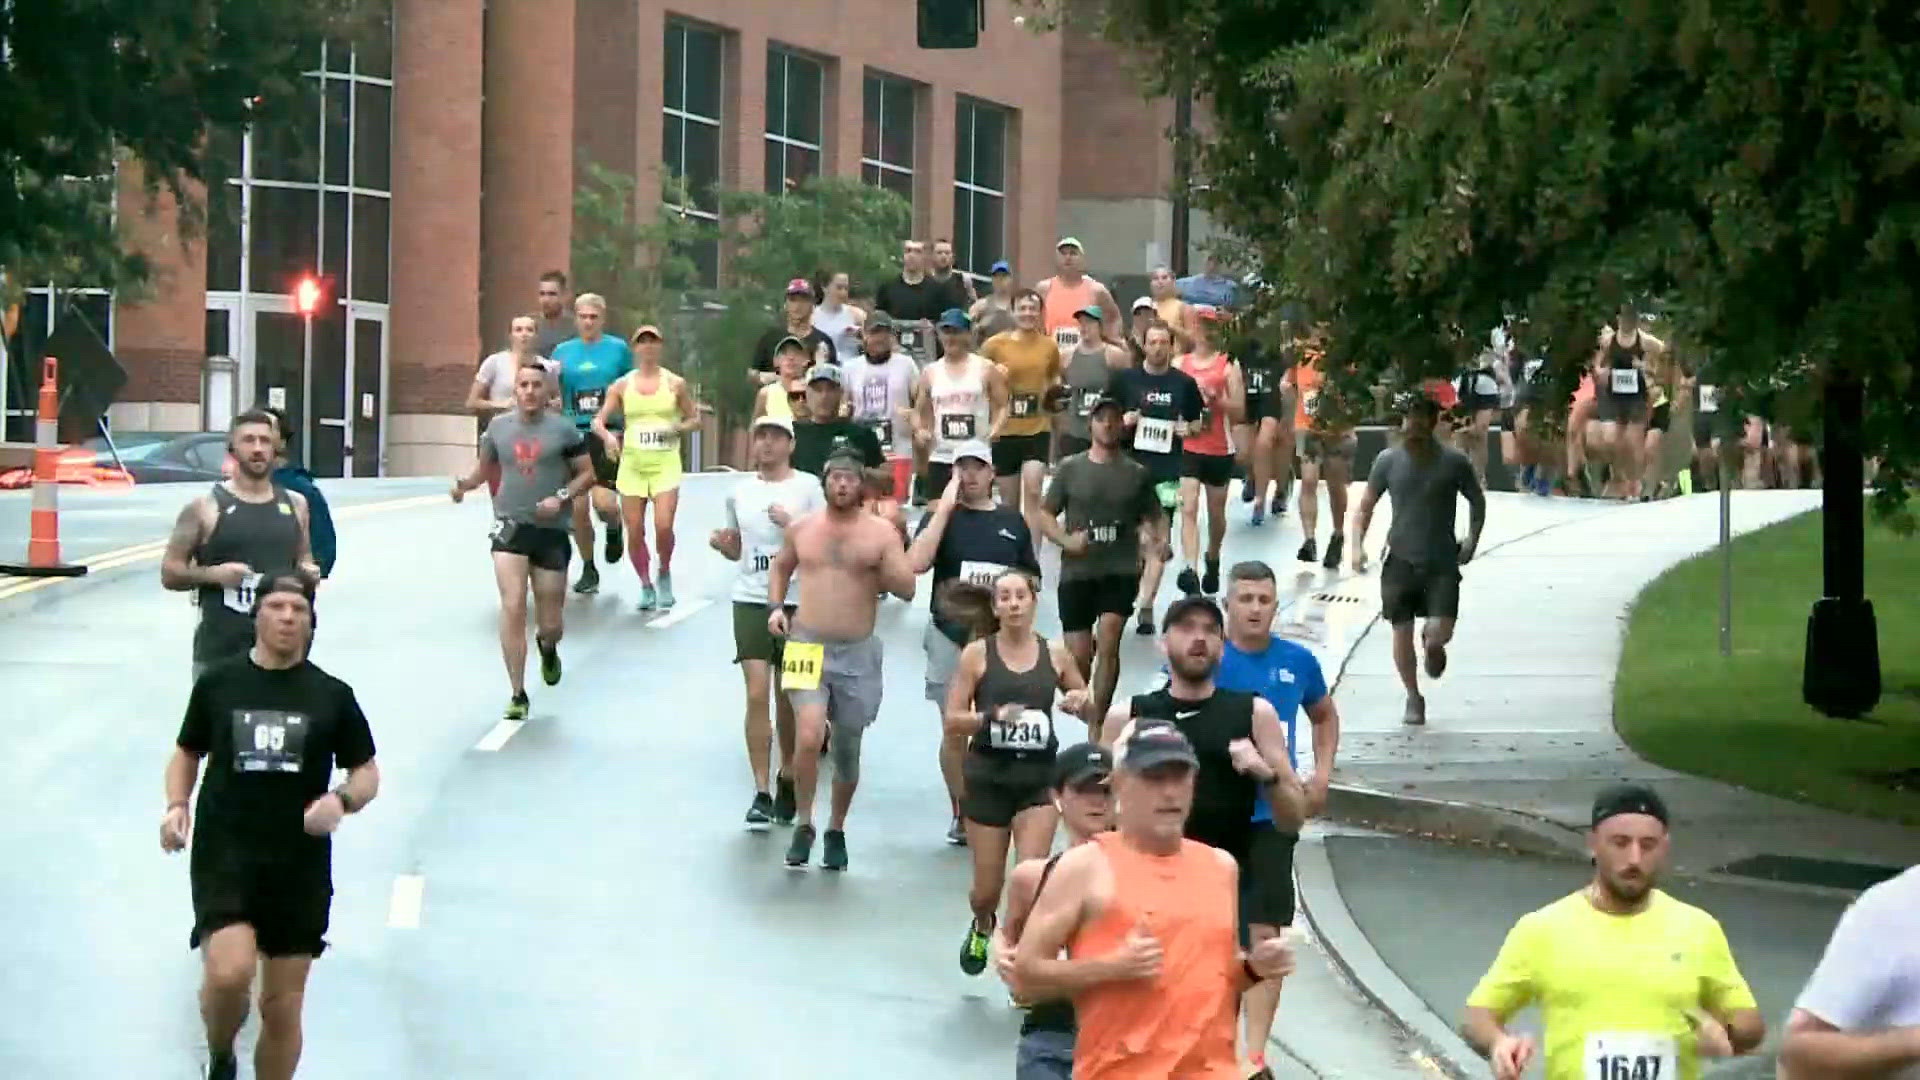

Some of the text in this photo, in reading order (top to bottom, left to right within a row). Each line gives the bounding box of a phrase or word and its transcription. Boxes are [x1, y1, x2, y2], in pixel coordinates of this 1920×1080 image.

[1146, 392, 1172, 403] CNS
[1001, 720, 1042, 744] 1234
[1596, 1055, 1660, 1080] 1647
